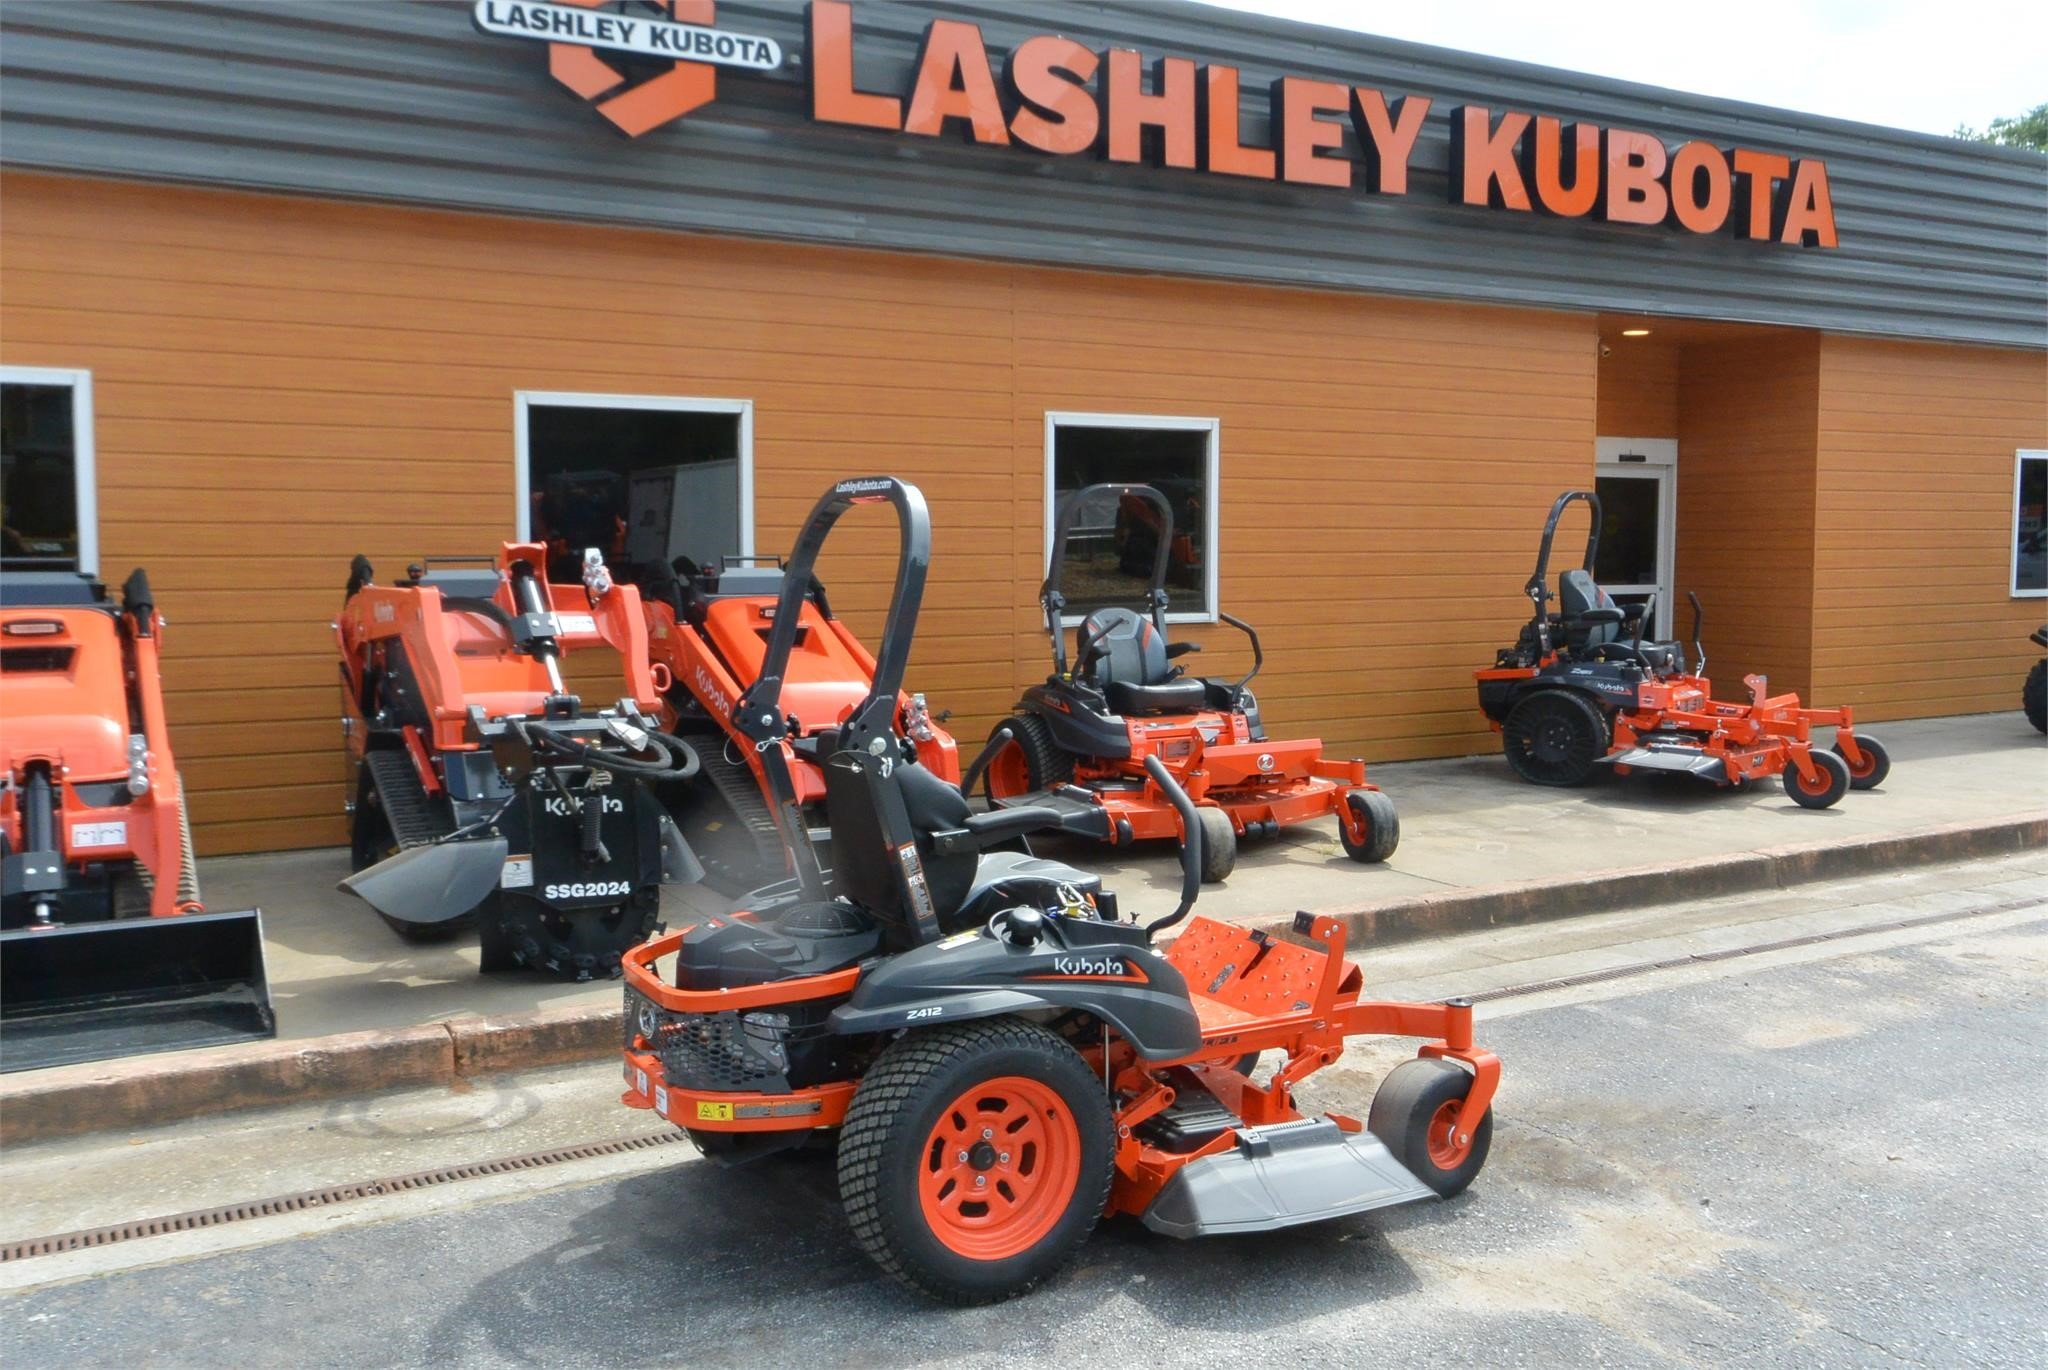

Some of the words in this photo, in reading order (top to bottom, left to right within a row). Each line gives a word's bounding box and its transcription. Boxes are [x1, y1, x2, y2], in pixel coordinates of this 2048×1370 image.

[486, 1, 636, 43] LASHLEY
[650, 25, 774, 64] KUBOTA
[810, 0, 1433, 196] LASHLEY
[1460, 104, 1839, 249] KUBOTA
[695, 664, 730, 719] Kubota
[544, 881, 631, 899] SSG2024
[1054, 957, 1124, 975] Kubota
[906, 1006, 944, 1020] Z412
